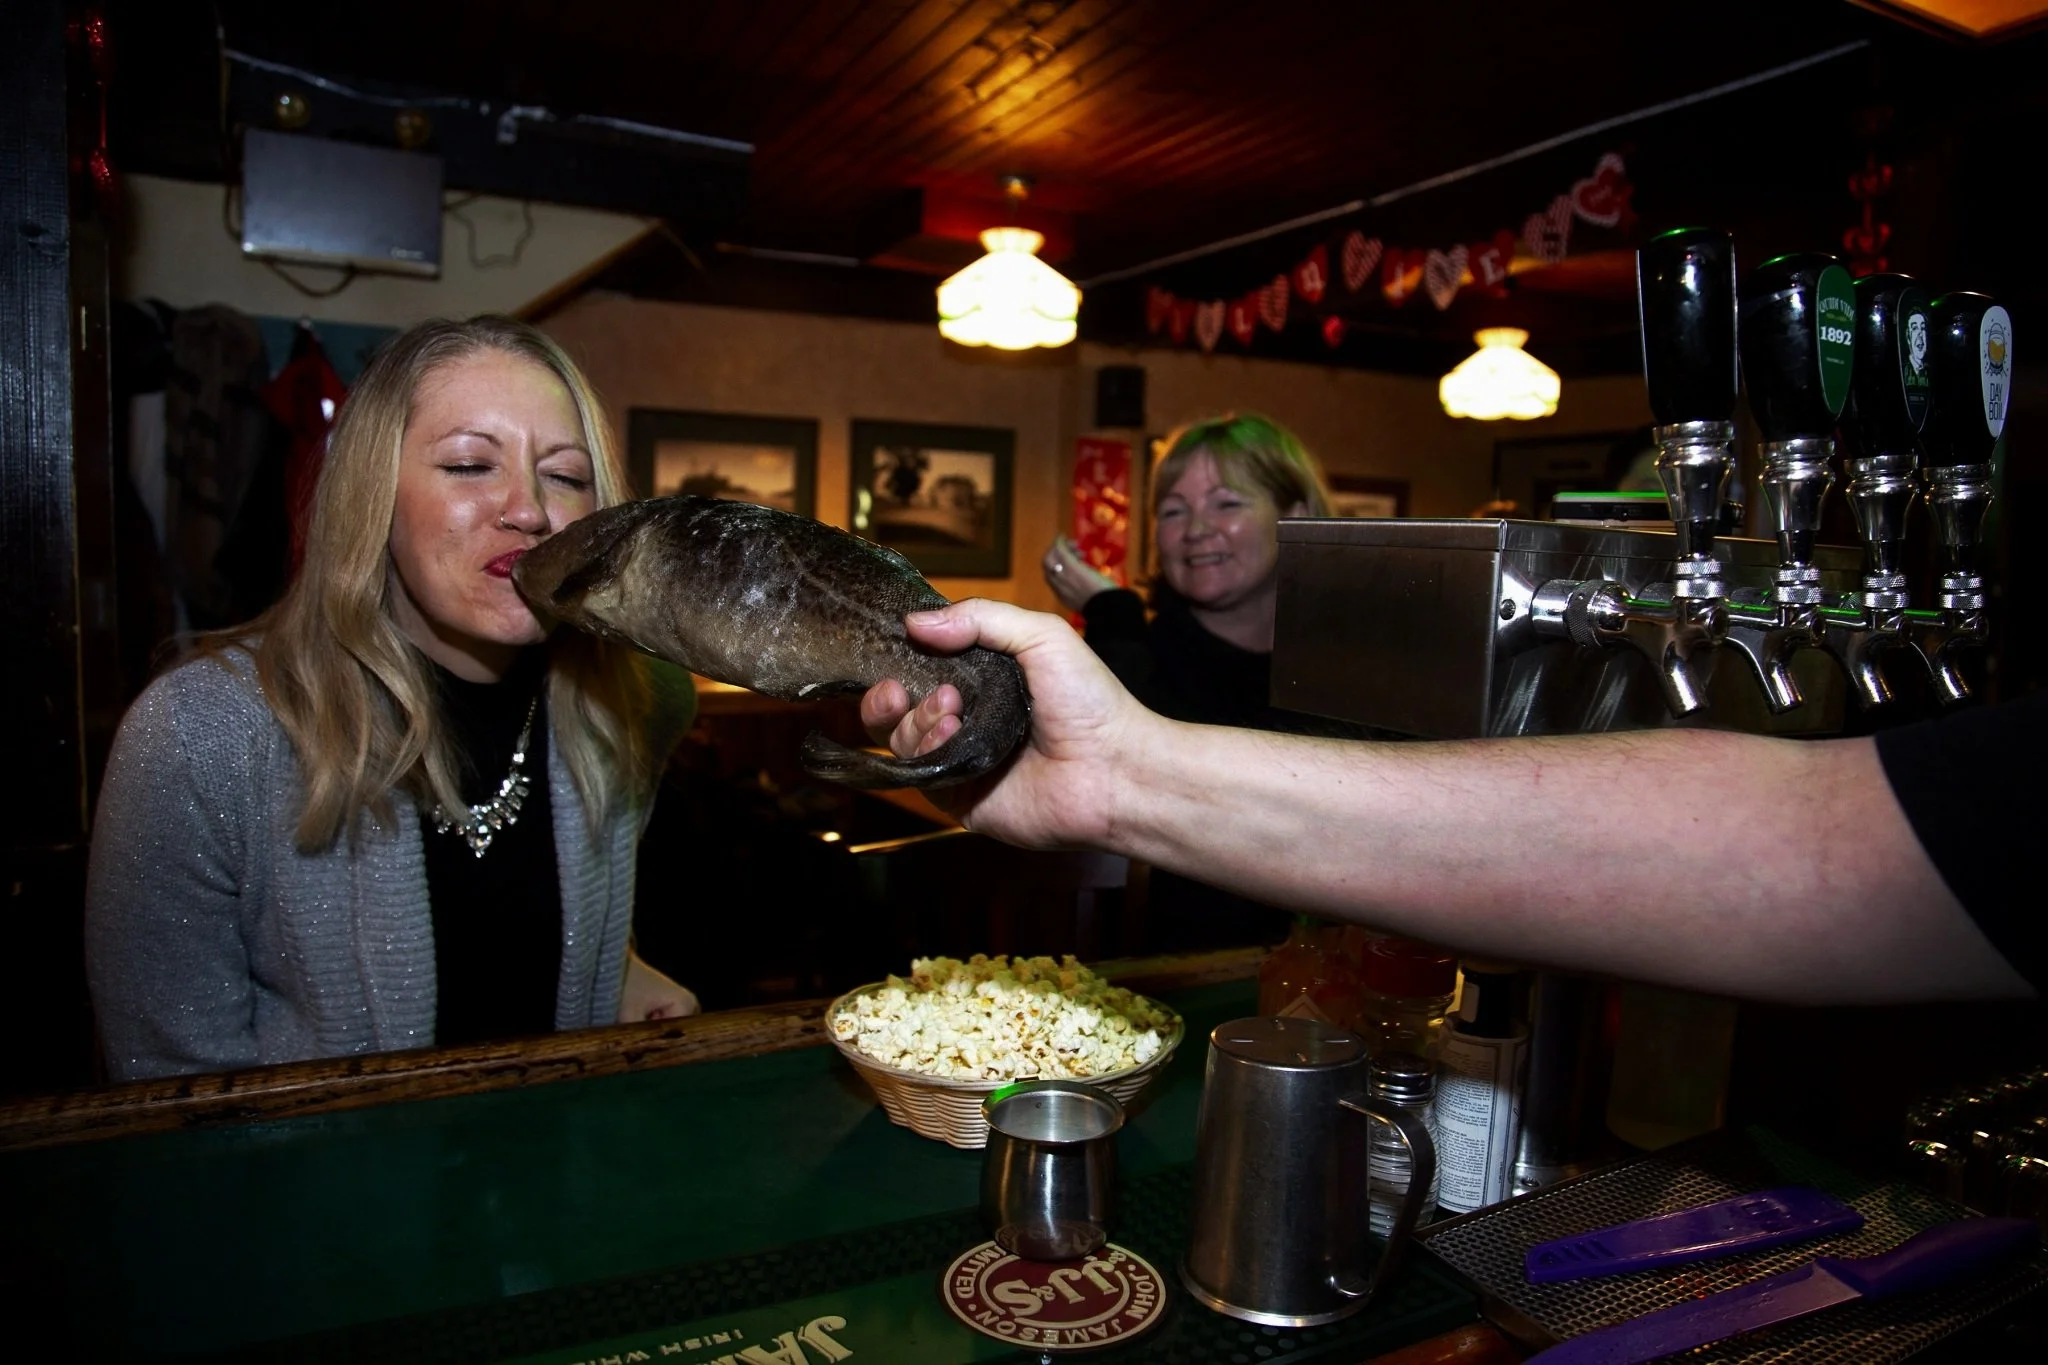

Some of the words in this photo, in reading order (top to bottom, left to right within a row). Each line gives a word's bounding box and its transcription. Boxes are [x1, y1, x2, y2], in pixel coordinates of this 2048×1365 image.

[1820, 325, 1852, 346] 1892
[1989, 382, 2003, 401] DAY
[955, 1245, 1007, 1299] IMITED
[1125, 1271, 1156, 1319] JOHN
[659, 1328, 744, 1356] IRISH
[697, 1314, 853, 1365] JA
[975, 1310, 1123, 1345] JAMESON
